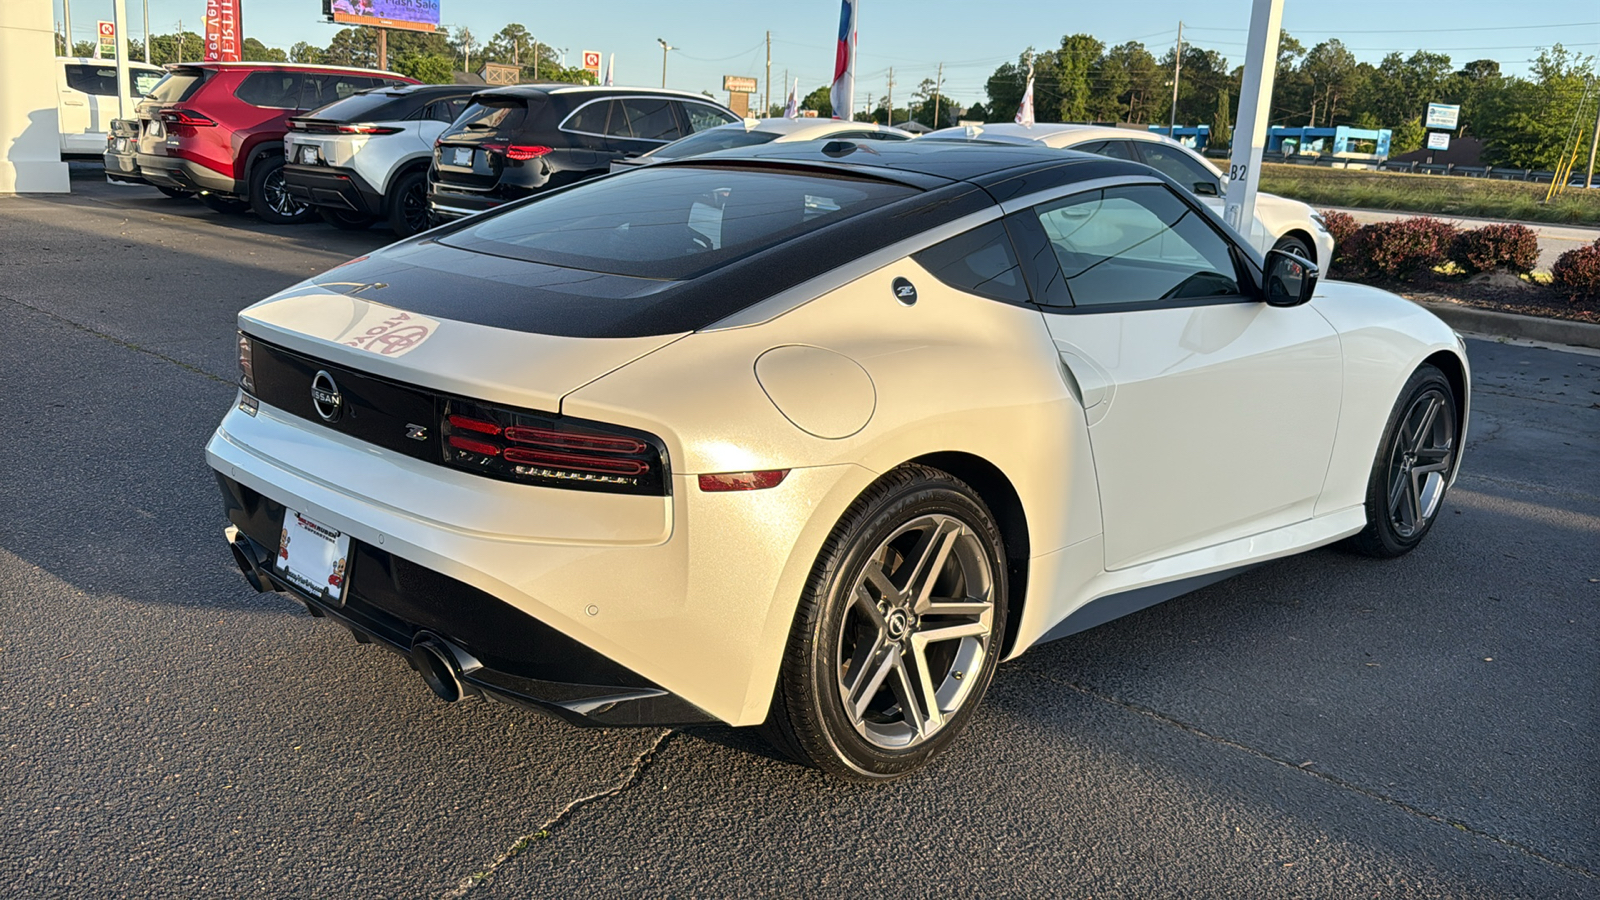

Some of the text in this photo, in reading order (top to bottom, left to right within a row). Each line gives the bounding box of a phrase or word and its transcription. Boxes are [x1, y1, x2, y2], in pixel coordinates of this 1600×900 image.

[415, 0, 438, 10] Sale
[1230, 164, 1247, 181] B2
[405, 422, 427, 441] Z
